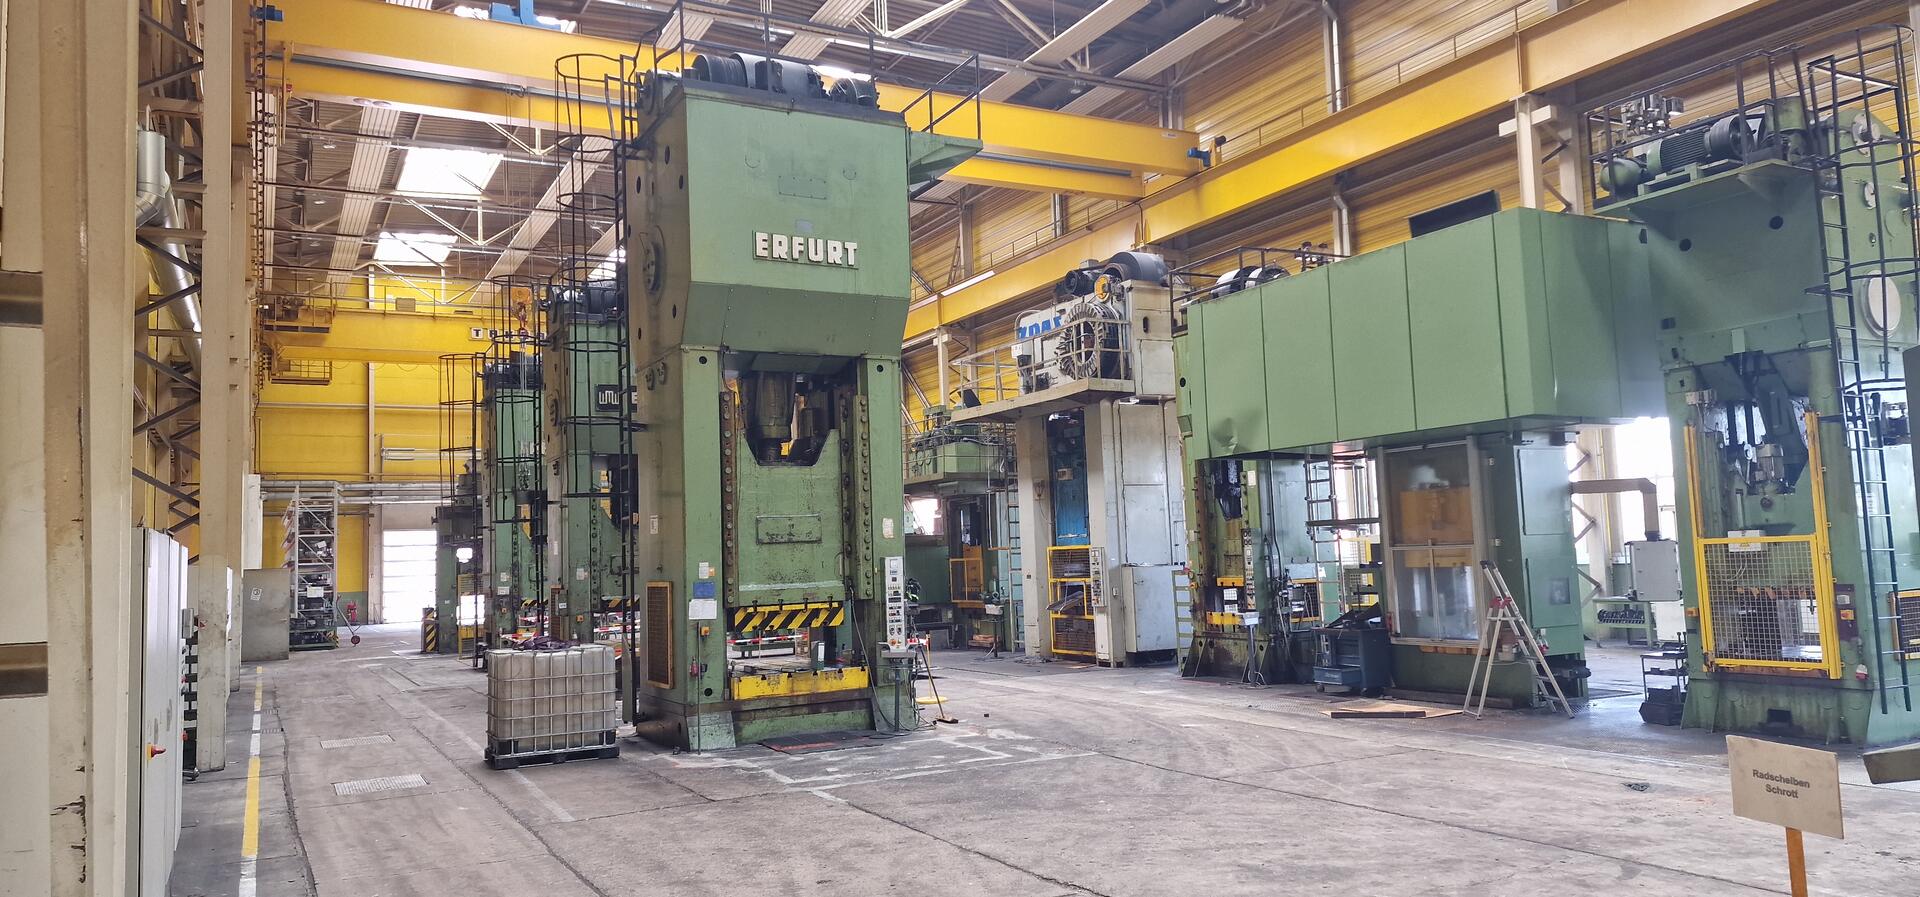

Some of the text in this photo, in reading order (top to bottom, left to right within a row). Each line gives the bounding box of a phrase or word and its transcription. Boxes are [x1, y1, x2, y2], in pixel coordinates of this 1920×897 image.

[755, 231, 858, 266] ERFURT
[1752, 769, 1810, 789] Radscheiben
[1765, 783, 1799, 799] Schrott
